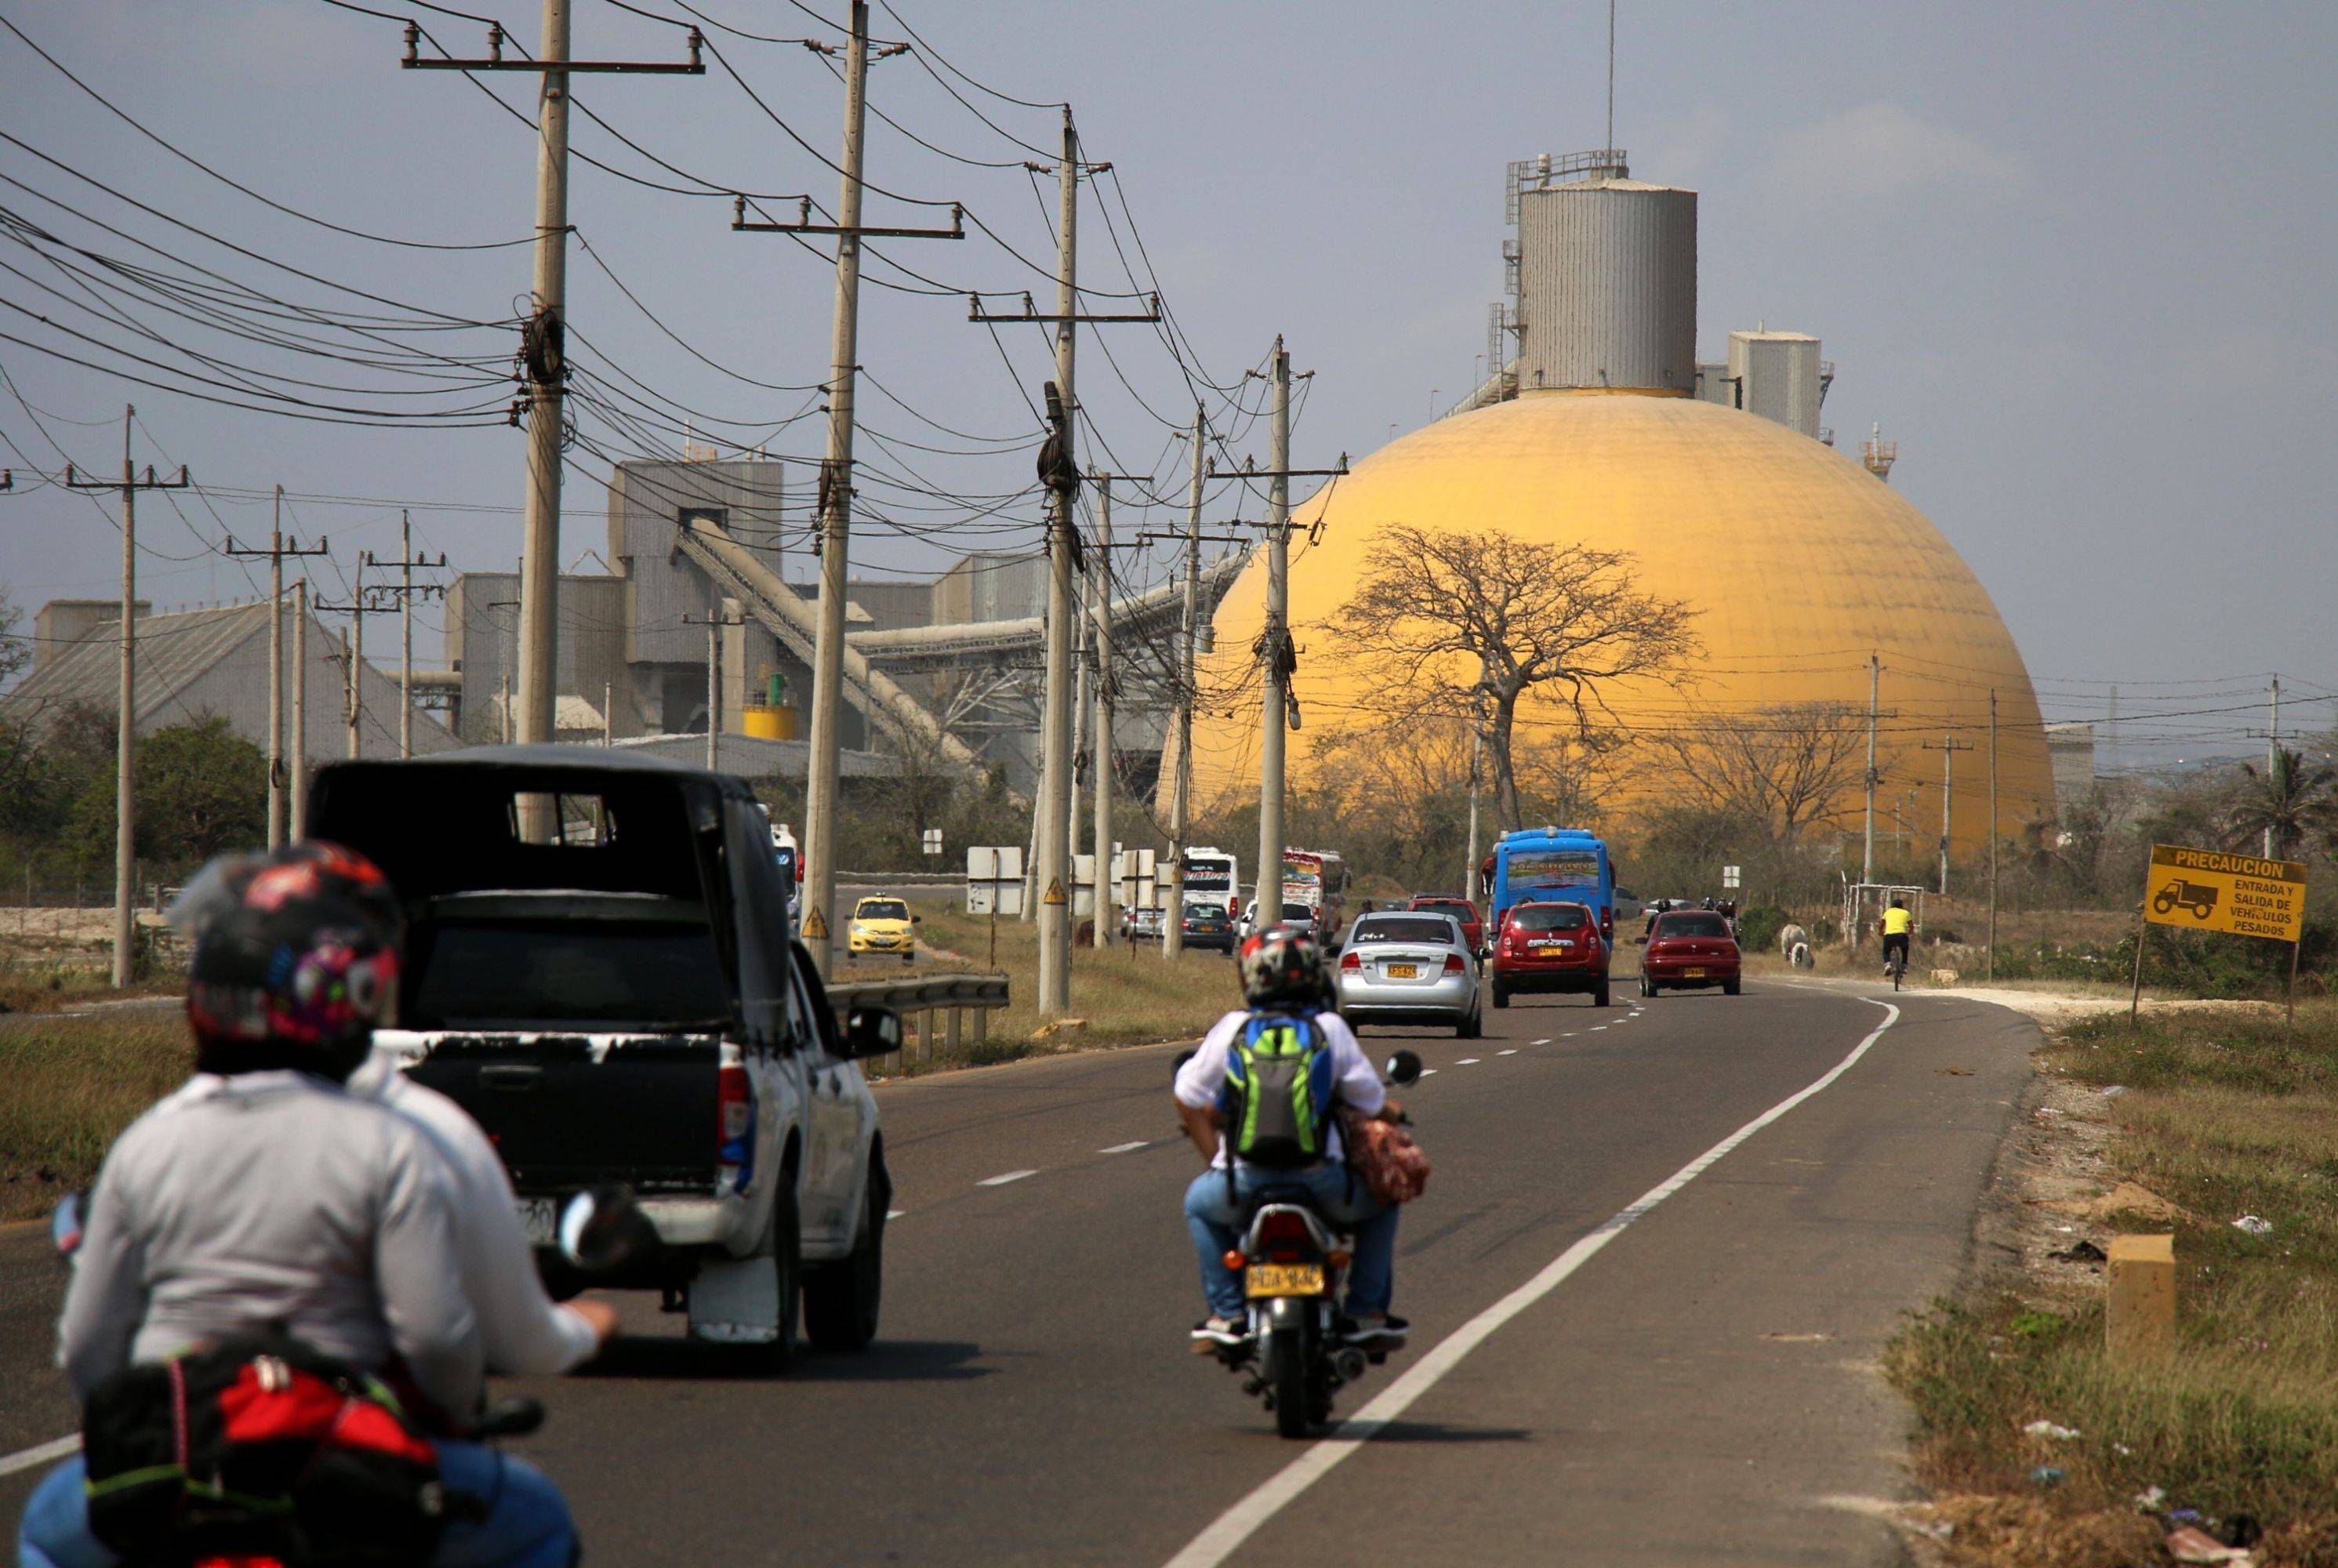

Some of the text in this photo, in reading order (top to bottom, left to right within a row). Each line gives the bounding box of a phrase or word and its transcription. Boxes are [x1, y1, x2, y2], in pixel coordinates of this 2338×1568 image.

[2176, 851, 2284, 878] PRECAUCION
[2235, 879, 2294, 896] ENTRADA Y
[2235, 893, 2291, 910] SALIDA DE
[2234, 920, 2285, 936] PESADOS
